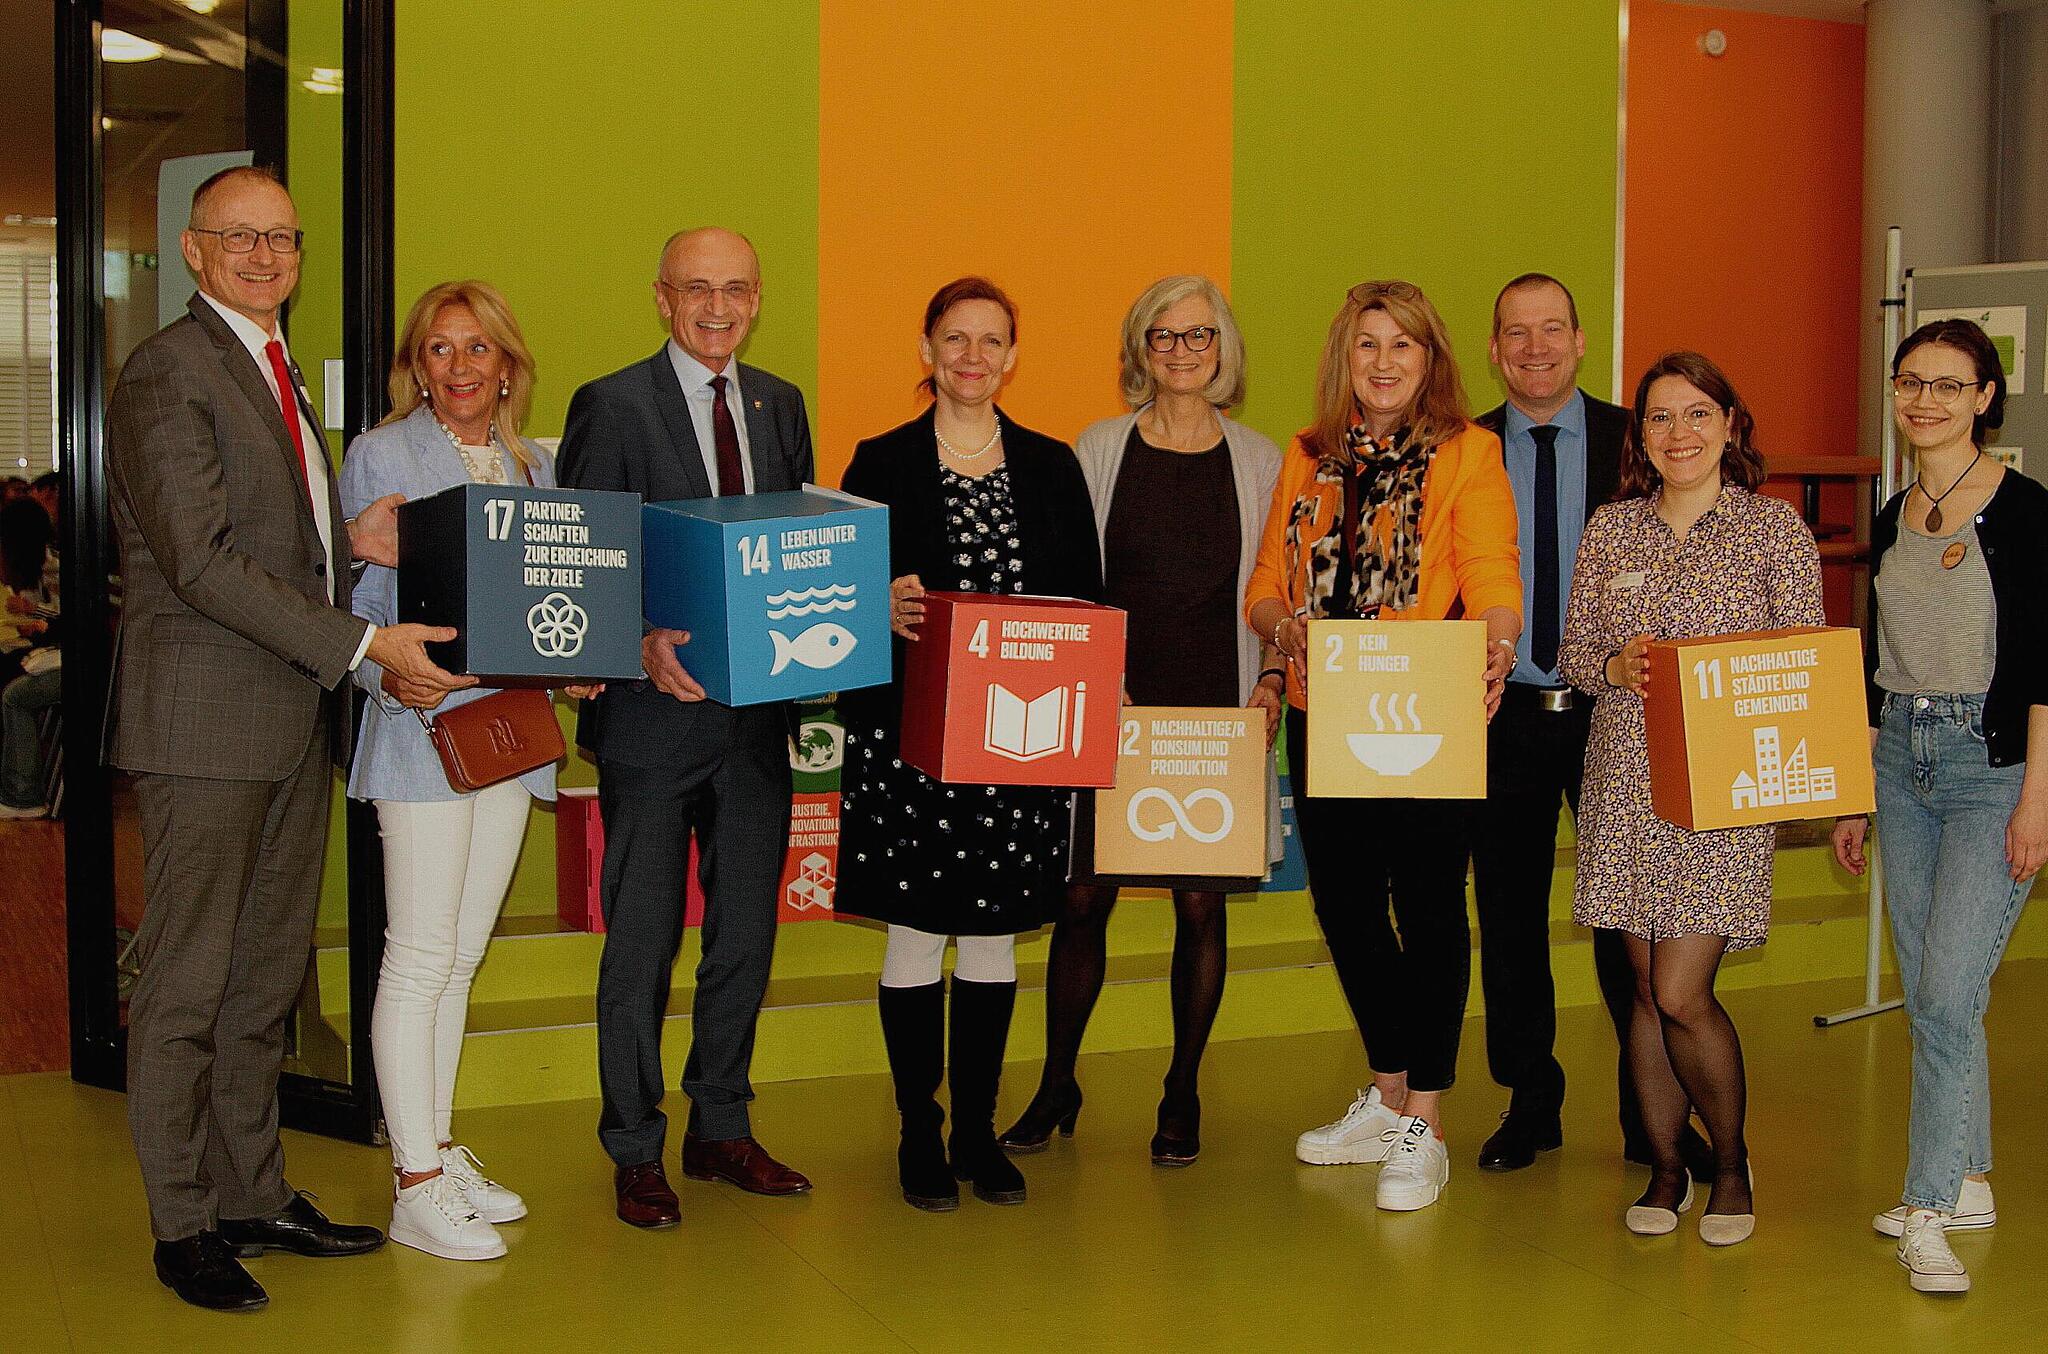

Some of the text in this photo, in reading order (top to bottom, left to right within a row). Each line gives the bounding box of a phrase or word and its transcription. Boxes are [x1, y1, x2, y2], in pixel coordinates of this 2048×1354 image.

[483, 499, 516, 541] 17
[523, 500, 585, 521] PARTNER-
[523, 522, 590, 545] SCHAFTEN
[780, 524, 857, 550] LEBEN UNTER
[523, 544, 628, 569] ZUR ERREICHUNG
[737, 534, 771, 576] 14
[781, 548, 833, 571] WASSER
[523, 567, 584, 588] DER ZIELE
[968, 619, 990, 659] 4
[1001, 620, 1091, 642] HOCHWERTIGE
[1359, 634, 1388, 651] KEIN
[1000, 641, 1055, 661] BILDUNG
[1324, 634, 1344, 672] 2
[1729, 648, 1819, 674] NACHHALTIGE
[1359, 655, 1409, 672] HUNGER
[1693, 658, 1723, 699] 11
[1731, 671, 1810, 696] STÄDTE UND
[1734, 693, 1809, 717] GEMEINDEN
[1118, 720, 1140, 755] 2
[1151, 720, 1246, 738] NACHHALTIGE/R
[1151, 740, 1228, 756] KONSUM UND
[1150, 759, 1228, 776] PRODUKTION
[791, 802, 833, 817] DUSTRIE,
[790, 816, 835, 832] NOVATION
